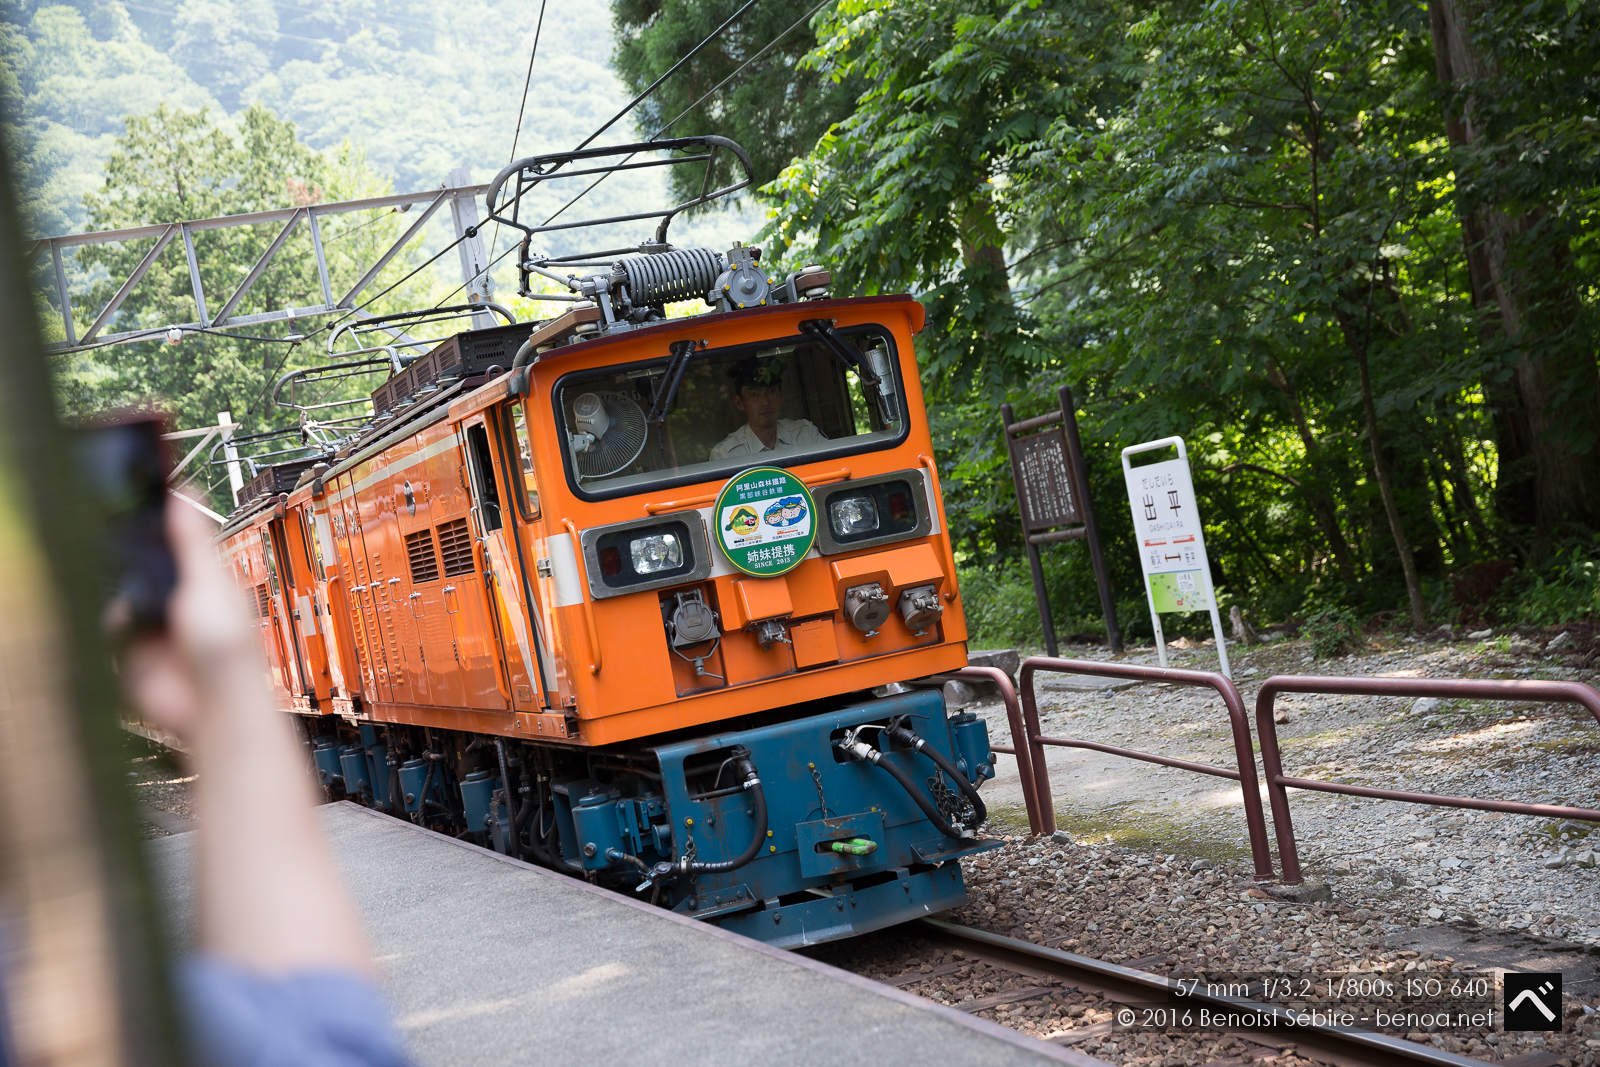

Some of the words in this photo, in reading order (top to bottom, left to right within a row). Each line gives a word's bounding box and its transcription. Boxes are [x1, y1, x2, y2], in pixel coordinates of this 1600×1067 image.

[747, 543, 796, 564] 姉妹提携
[754, 561, 773, 569] SINCE
